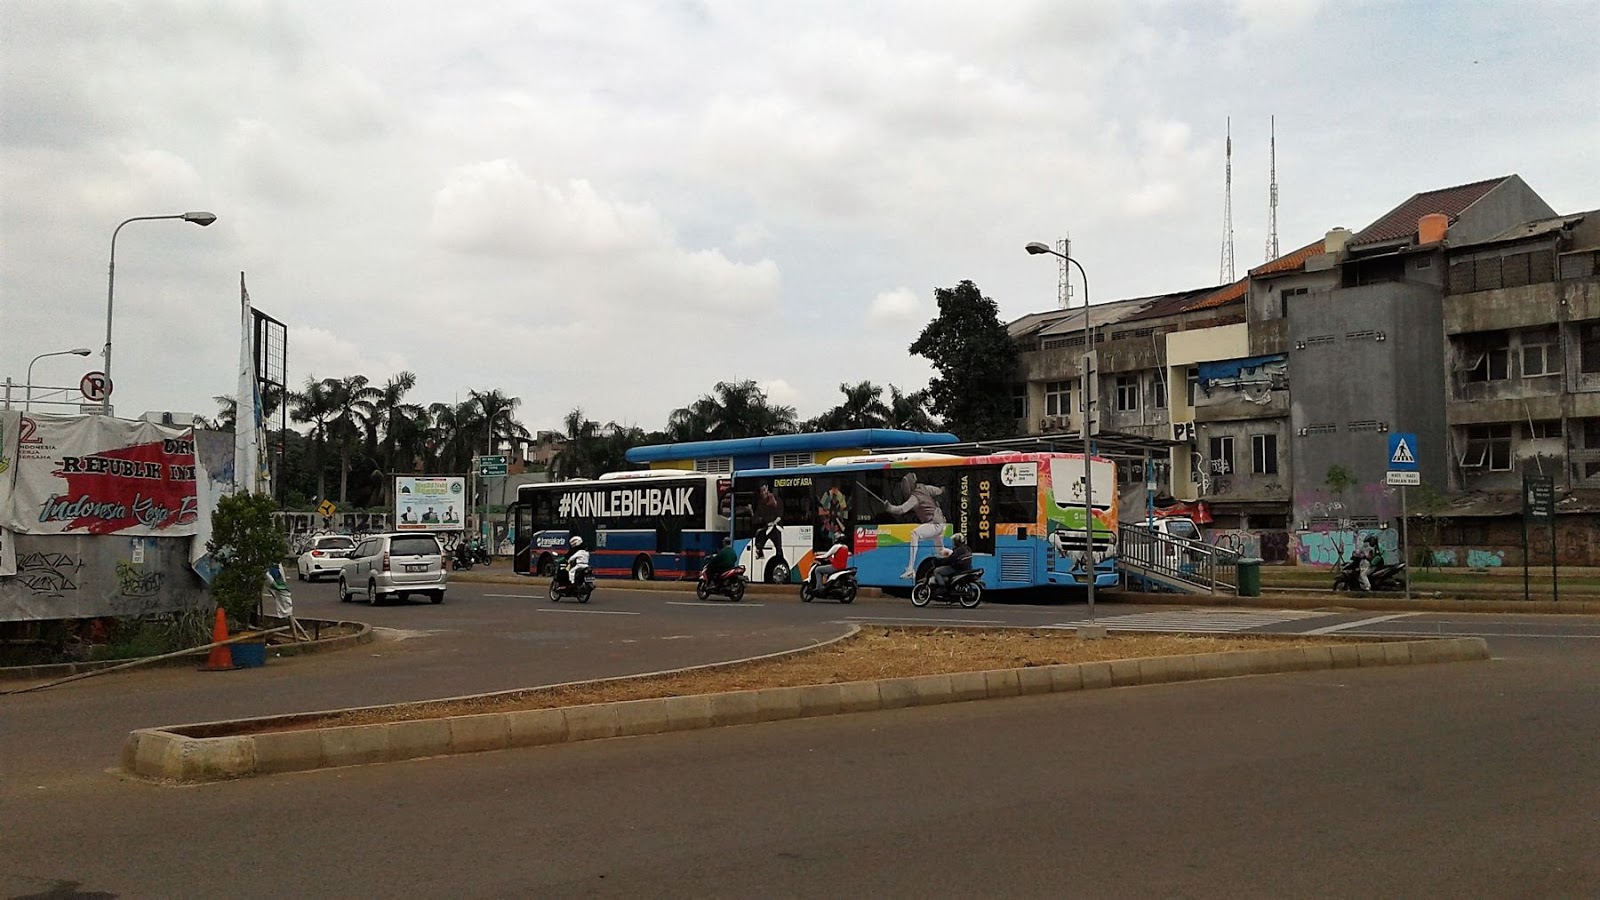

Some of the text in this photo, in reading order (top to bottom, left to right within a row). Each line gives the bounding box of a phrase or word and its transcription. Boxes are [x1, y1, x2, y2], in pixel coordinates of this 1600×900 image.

[61, 455, 162, 479] REPUBLIK
[38, 494, 125, 523] Indonesia
[558, 487, 695, 517] #KINILEBIHBAIK
[961, 496, 968, 509] OF
